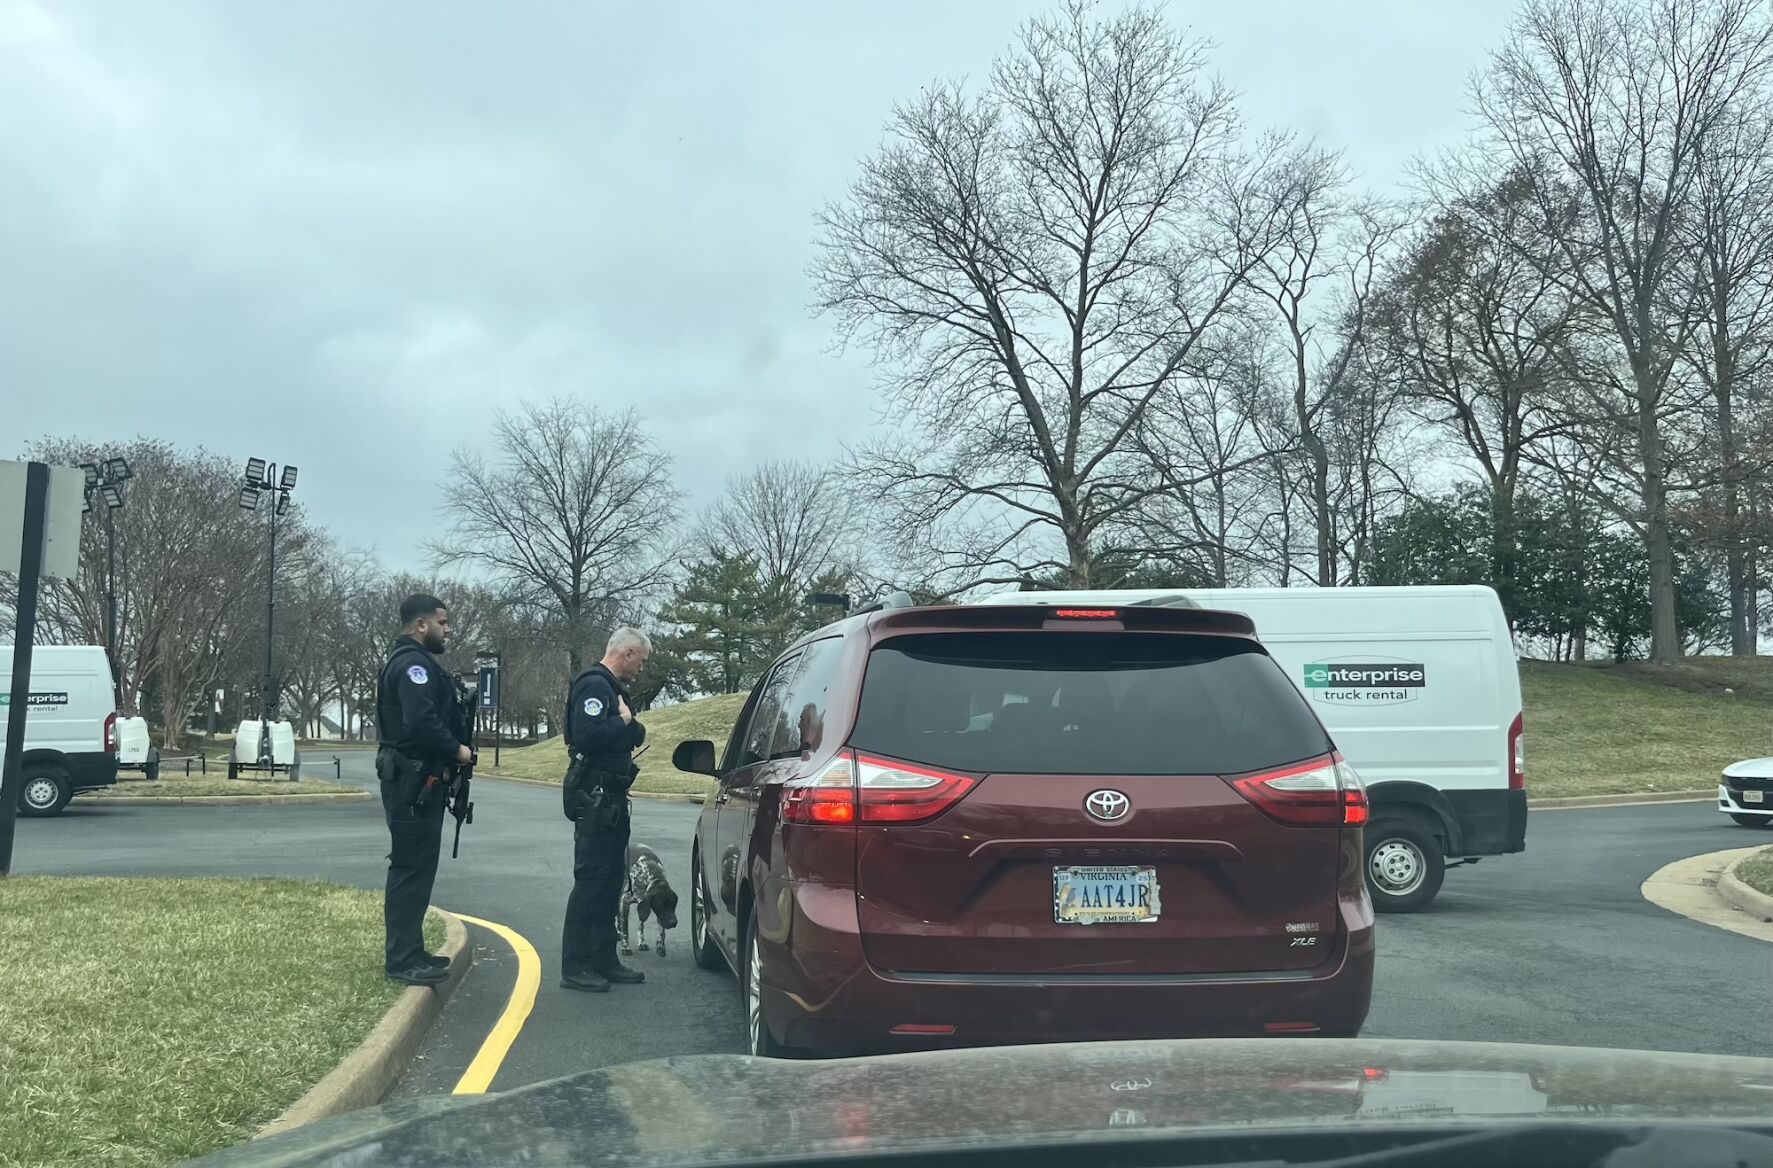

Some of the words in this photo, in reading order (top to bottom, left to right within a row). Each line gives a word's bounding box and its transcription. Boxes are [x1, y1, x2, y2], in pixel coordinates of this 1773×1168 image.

[1304, 667, 1423, 685] enterprise
[1324, 689, 1361, 700] truck
[1366, 689, 1407, 700] rental
[1080, 872, 1128, 881] VIRGINIA
[1081, 884, 1149, 908] AAT4JR
[1290, 937, 1317, 947] XLE
